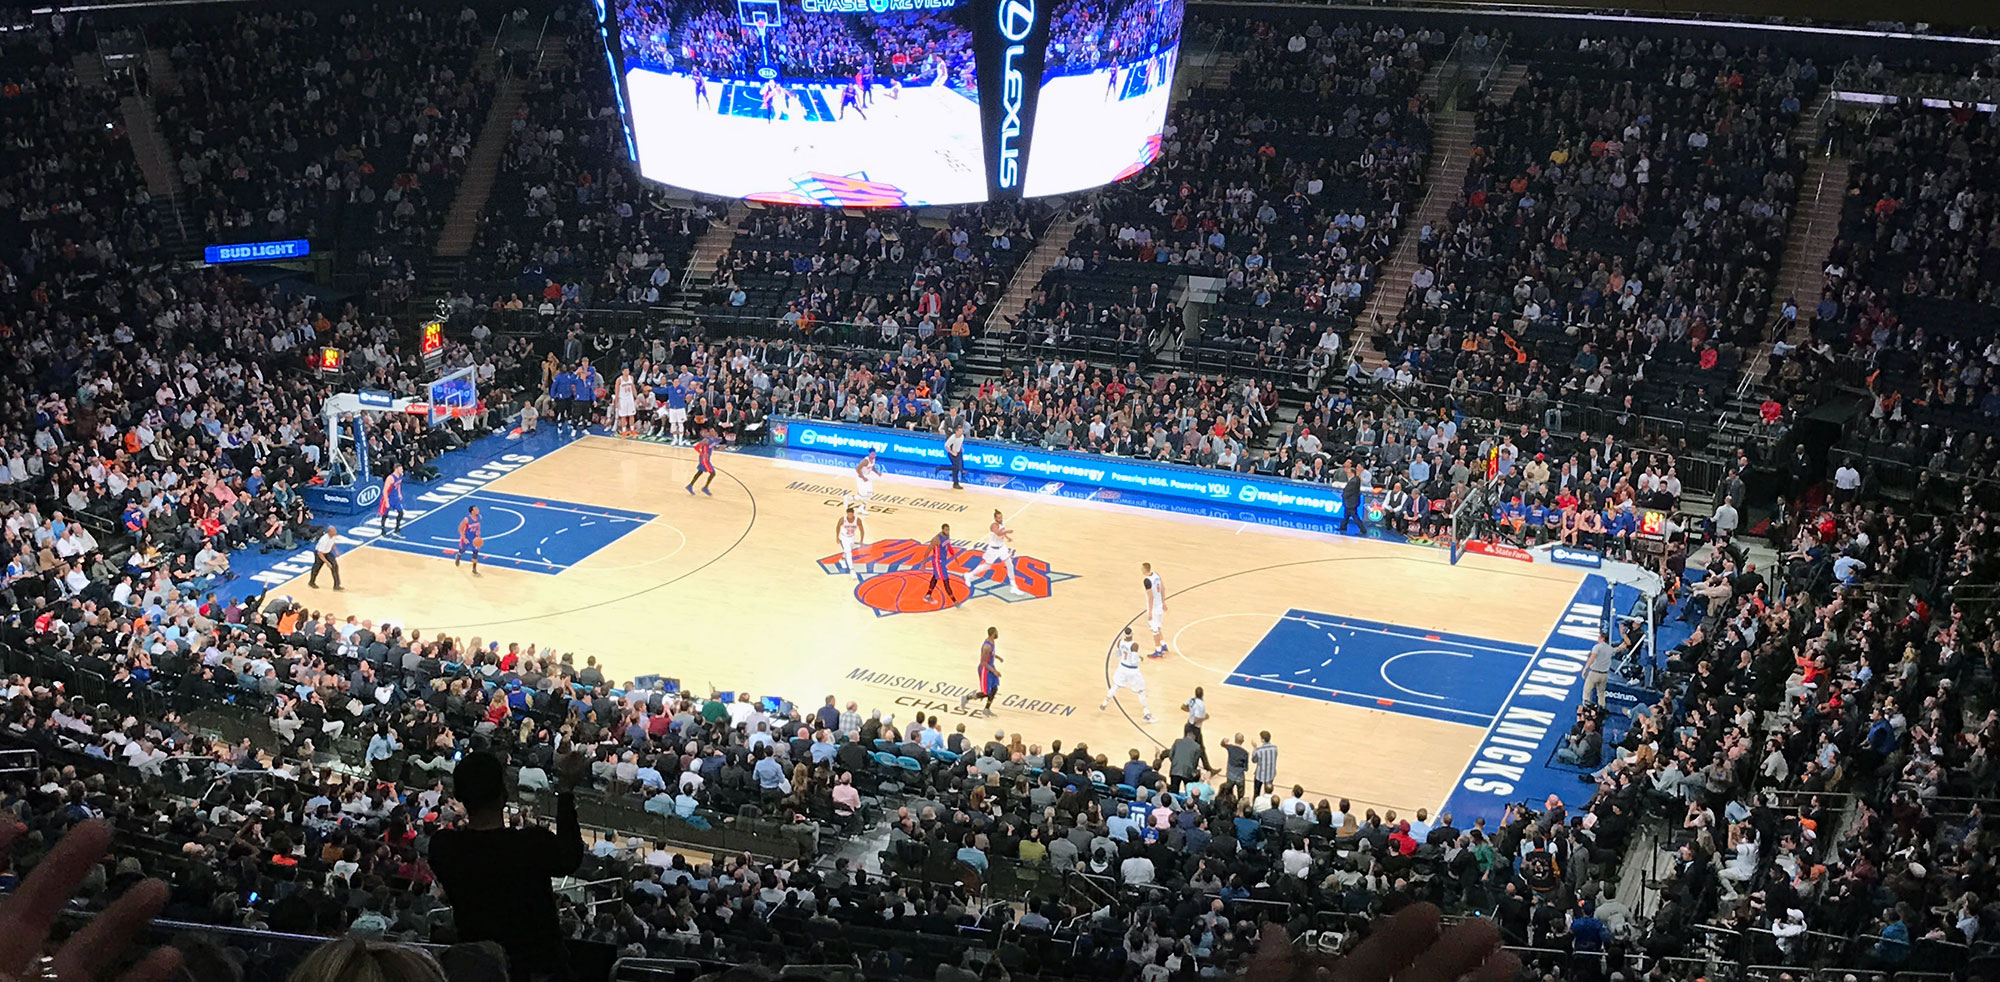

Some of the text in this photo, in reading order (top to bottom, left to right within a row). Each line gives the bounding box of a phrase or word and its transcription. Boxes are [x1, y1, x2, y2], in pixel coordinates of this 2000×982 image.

[1000, 45, 1024, 188] LEXUS
[220, 244, 295, 259] BUD LIGHT
[426, 334, 439, 351] 24
[893, 444, 927, 457] Powering
[1111, 472, 1147, 485] Powering
[1170, 480, 1206, 493] Powering
[360, 488, 378, 503] KIA
[786, 481, 852, 497] MADISON
[909, 497, 968, 513] GARDEN
[250, 551, 316, 584] NEW
[416, 453, 536, 503] KNICKS
[818, 538, 1051, 598] KNCKS
[1495, 546, 1530, 560] State Farm
[846, 667, 929, 691] MADISON
[1002, 694, 1077, 717] GARDEN
[894, 696, 985, 719] CHASE
[1463, 602, 1603, 796] NEW YORK KNICKS
[1604, 690, 1636, 703] pectrum
